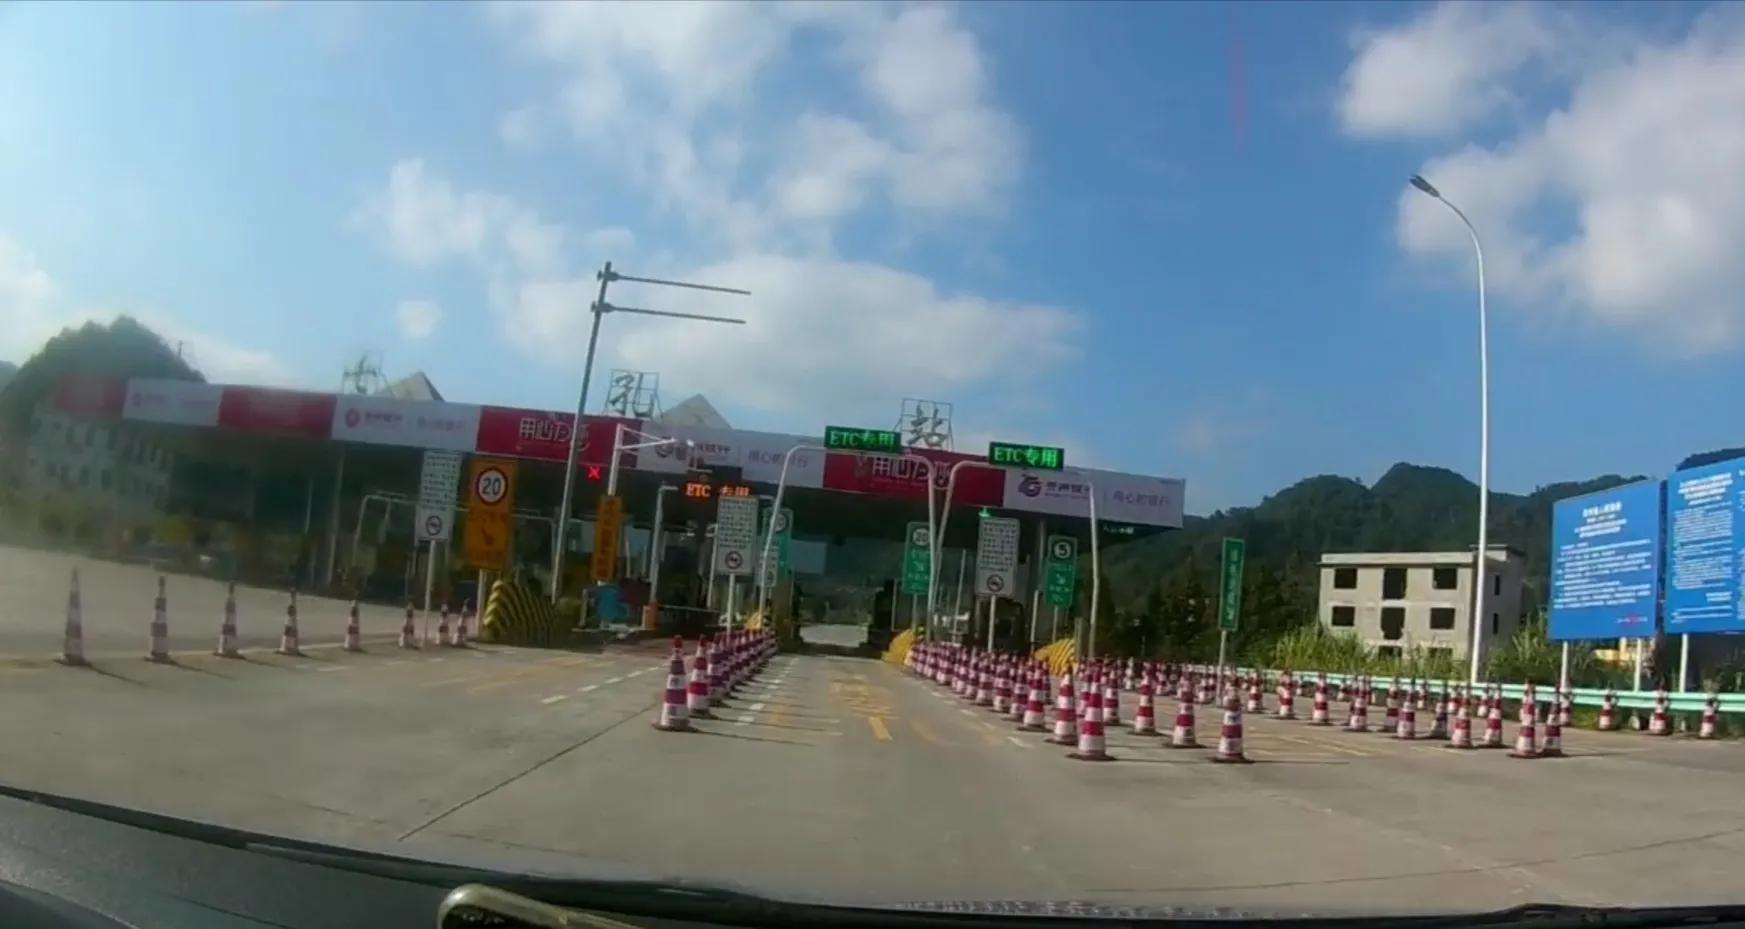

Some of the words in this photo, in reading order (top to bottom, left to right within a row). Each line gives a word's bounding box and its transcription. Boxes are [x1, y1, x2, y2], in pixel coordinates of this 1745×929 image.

[907, 403, 947, 448] 站
[829, 430, 895, 448] ETC专用
[993, 447, 1058, 469] ETC专用
[481, 477, 501, 496] 20
[686, 483, 711, 498] ETC
